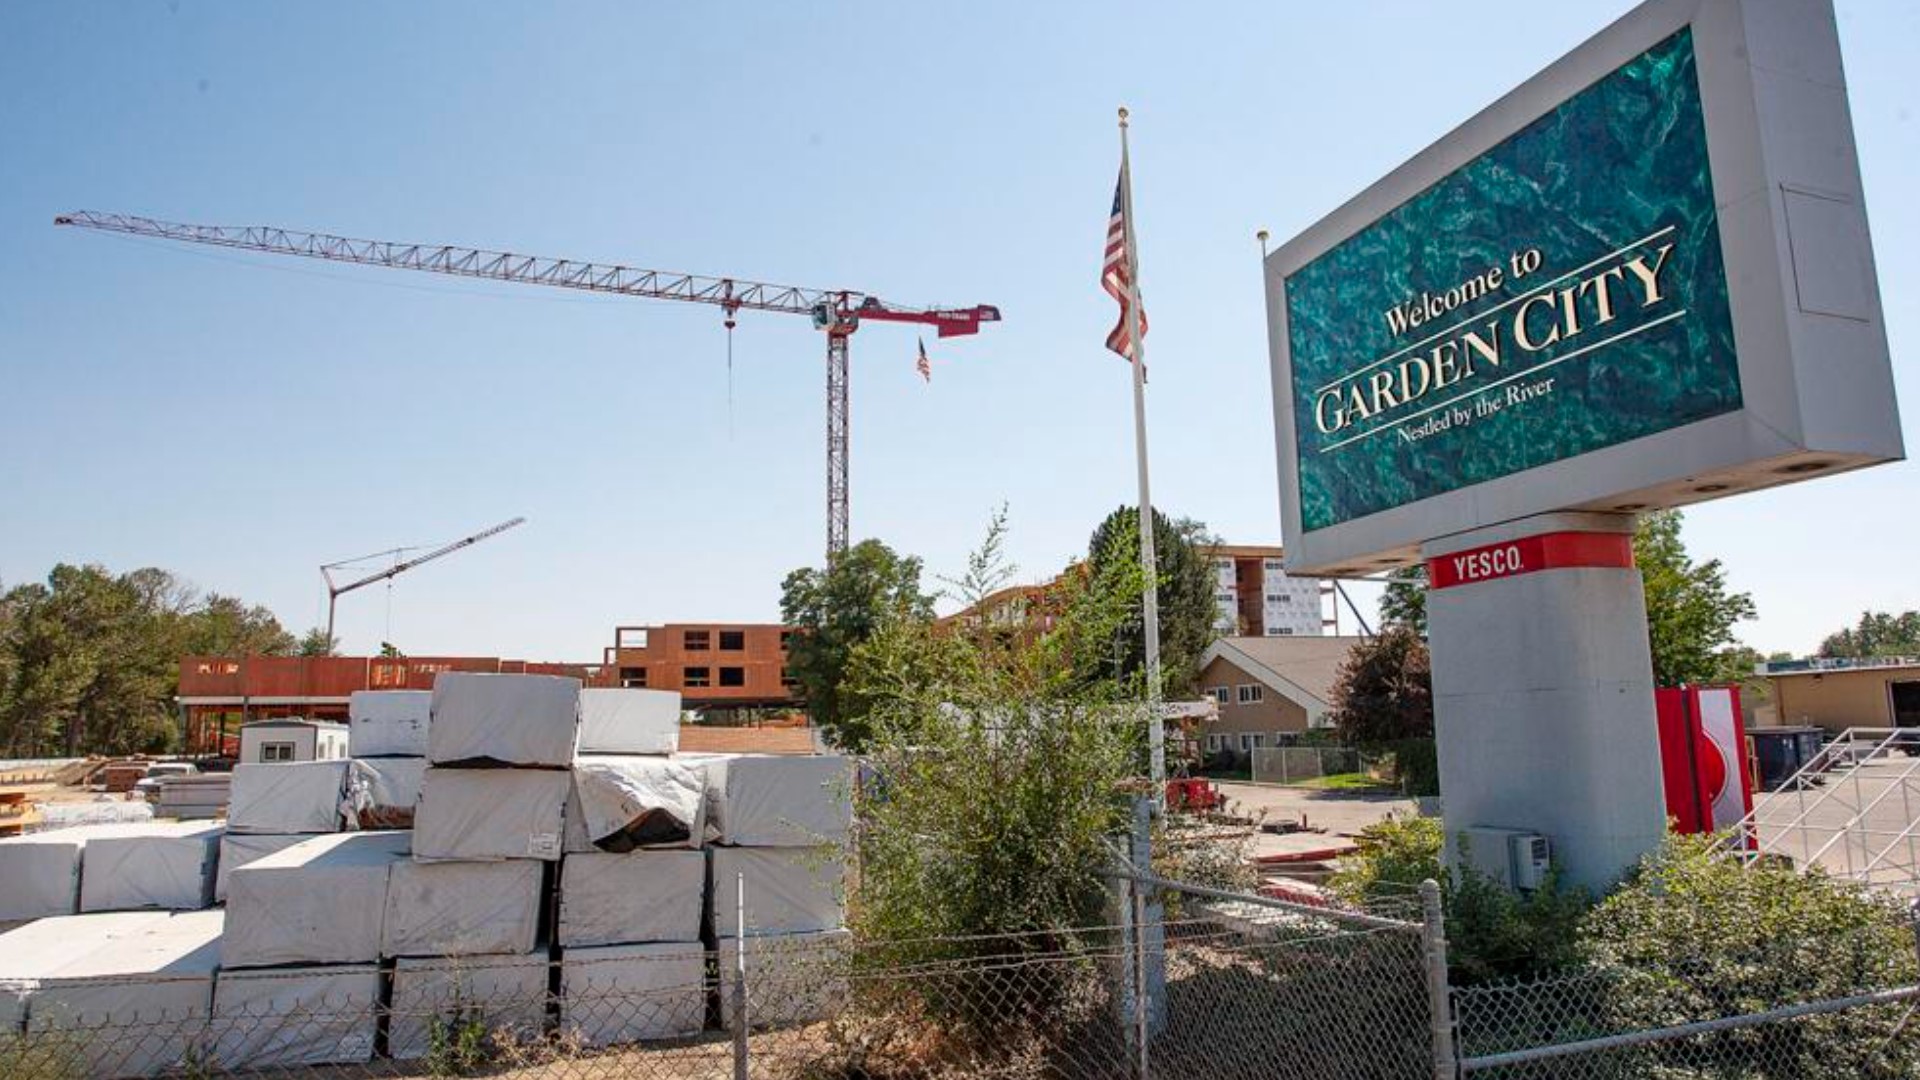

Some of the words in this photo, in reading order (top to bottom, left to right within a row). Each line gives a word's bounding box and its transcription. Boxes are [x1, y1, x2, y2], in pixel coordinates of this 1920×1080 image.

[1385, 266, 1503, 338] Welcome
[1509, 249, 1542, 279] to
[1315, 320, 1500, 434] GARDEN
[1514, 243, 1674, 351] CITY
[1397, 410, 1451, 446] Nestled
[1454, 408, 1472, 426] by
[1475, 398, 1501, 418] the
[1505, 378, 1556, 406] River
